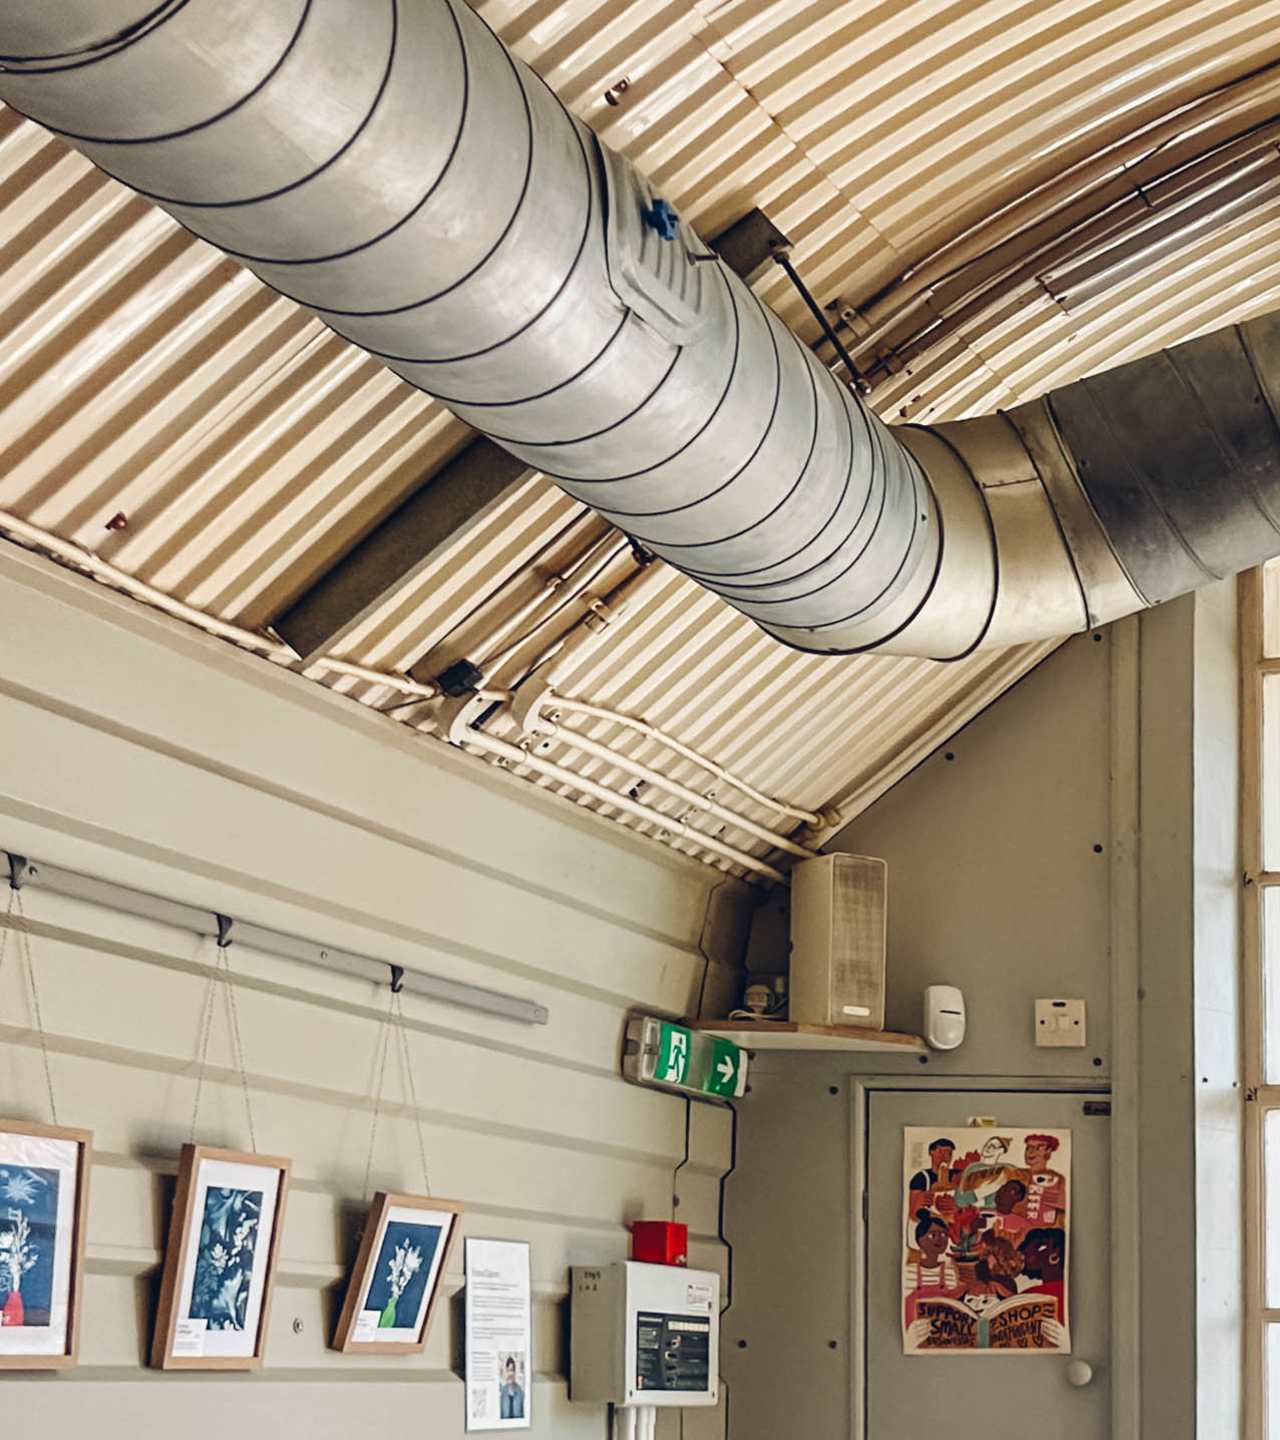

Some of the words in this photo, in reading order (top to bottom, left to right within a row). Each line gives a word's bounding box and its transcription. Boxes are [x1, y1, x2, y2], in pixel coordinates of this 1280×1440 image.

[918, 1302, 976, 1326] SUPPORT
[1000, 1304, 1042, 1327] SHOP
[930, 1319, 973, 1337] SMALL
